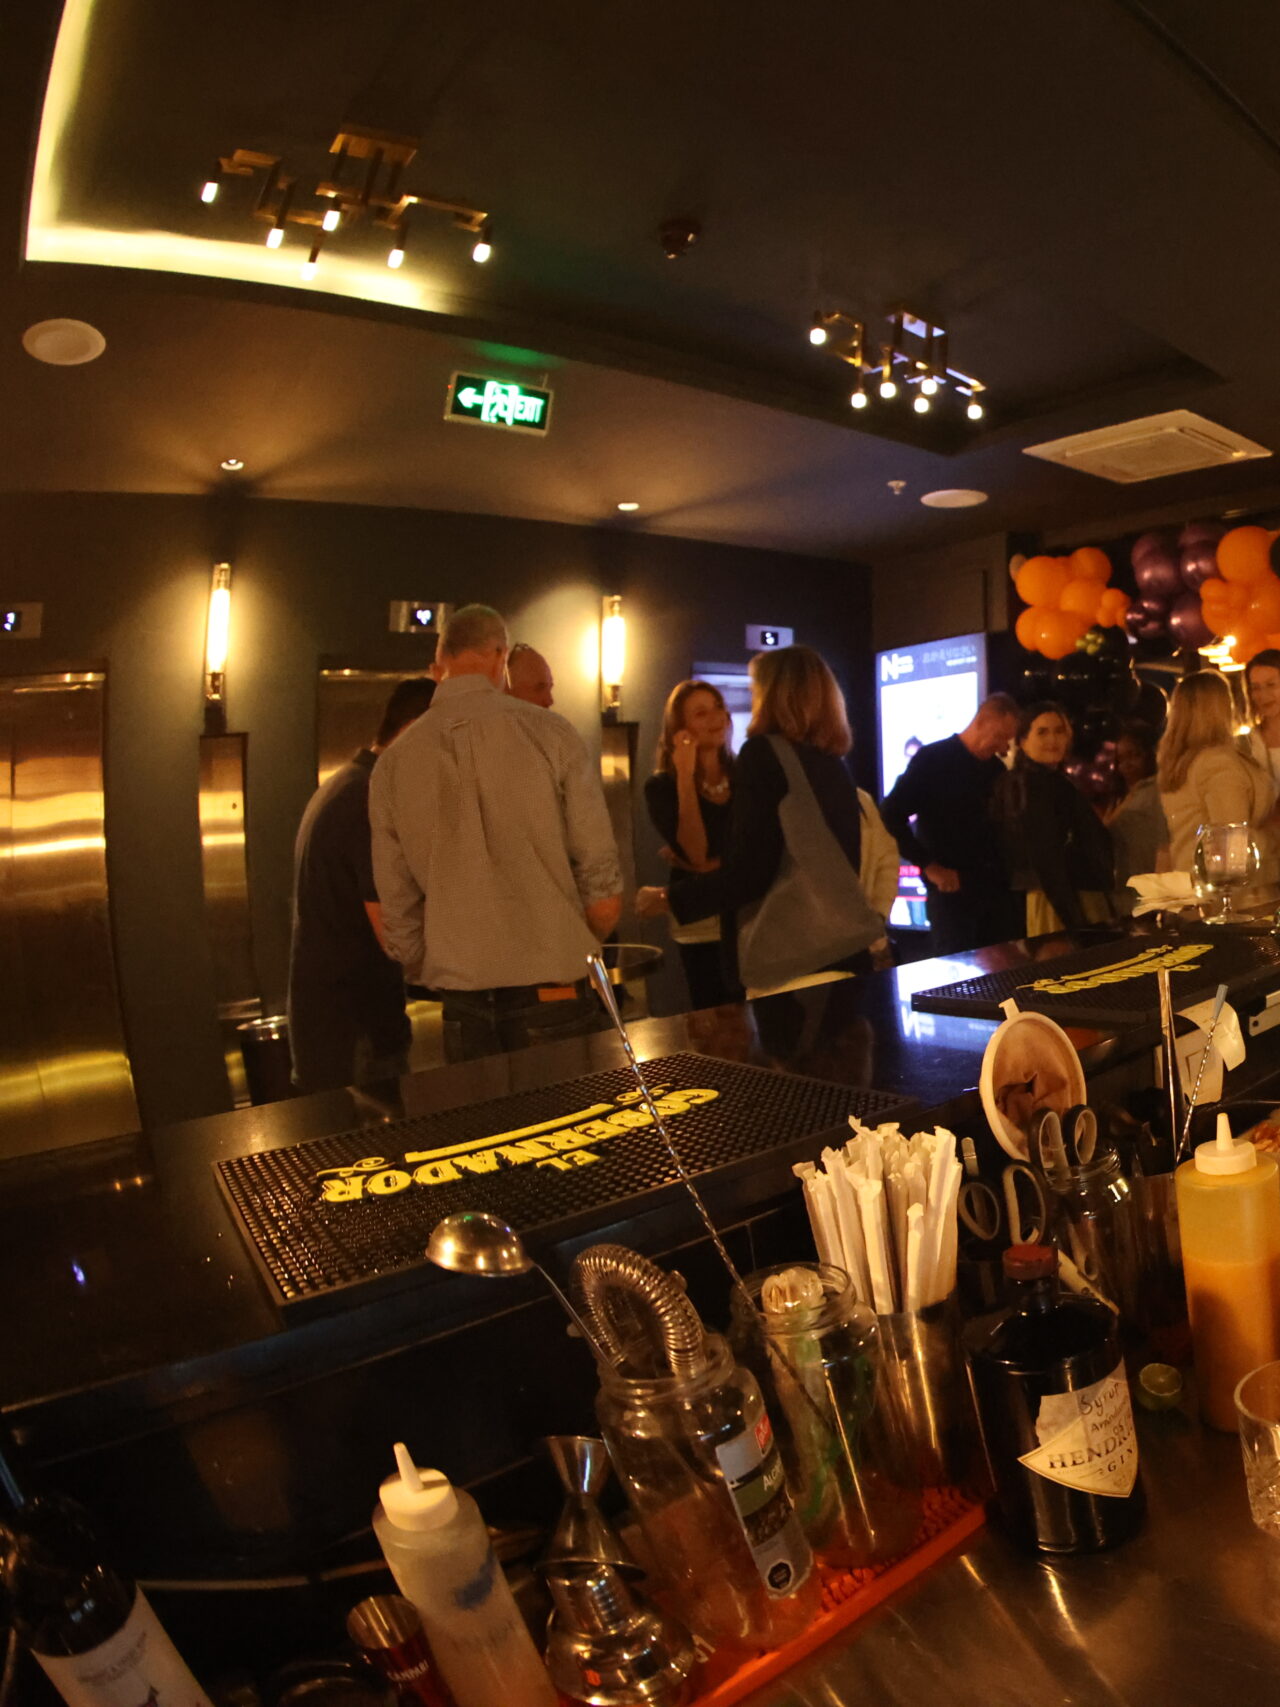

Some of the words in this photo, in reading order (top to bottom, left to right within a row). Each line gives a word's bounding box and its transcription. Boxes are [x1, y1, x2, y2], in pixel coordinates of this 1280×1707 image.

[514, 395, 544, 423] EXIT
[321, 1088, 720, 1203] GOBERNADOR
[535, 1149, 601, 1171] EL
